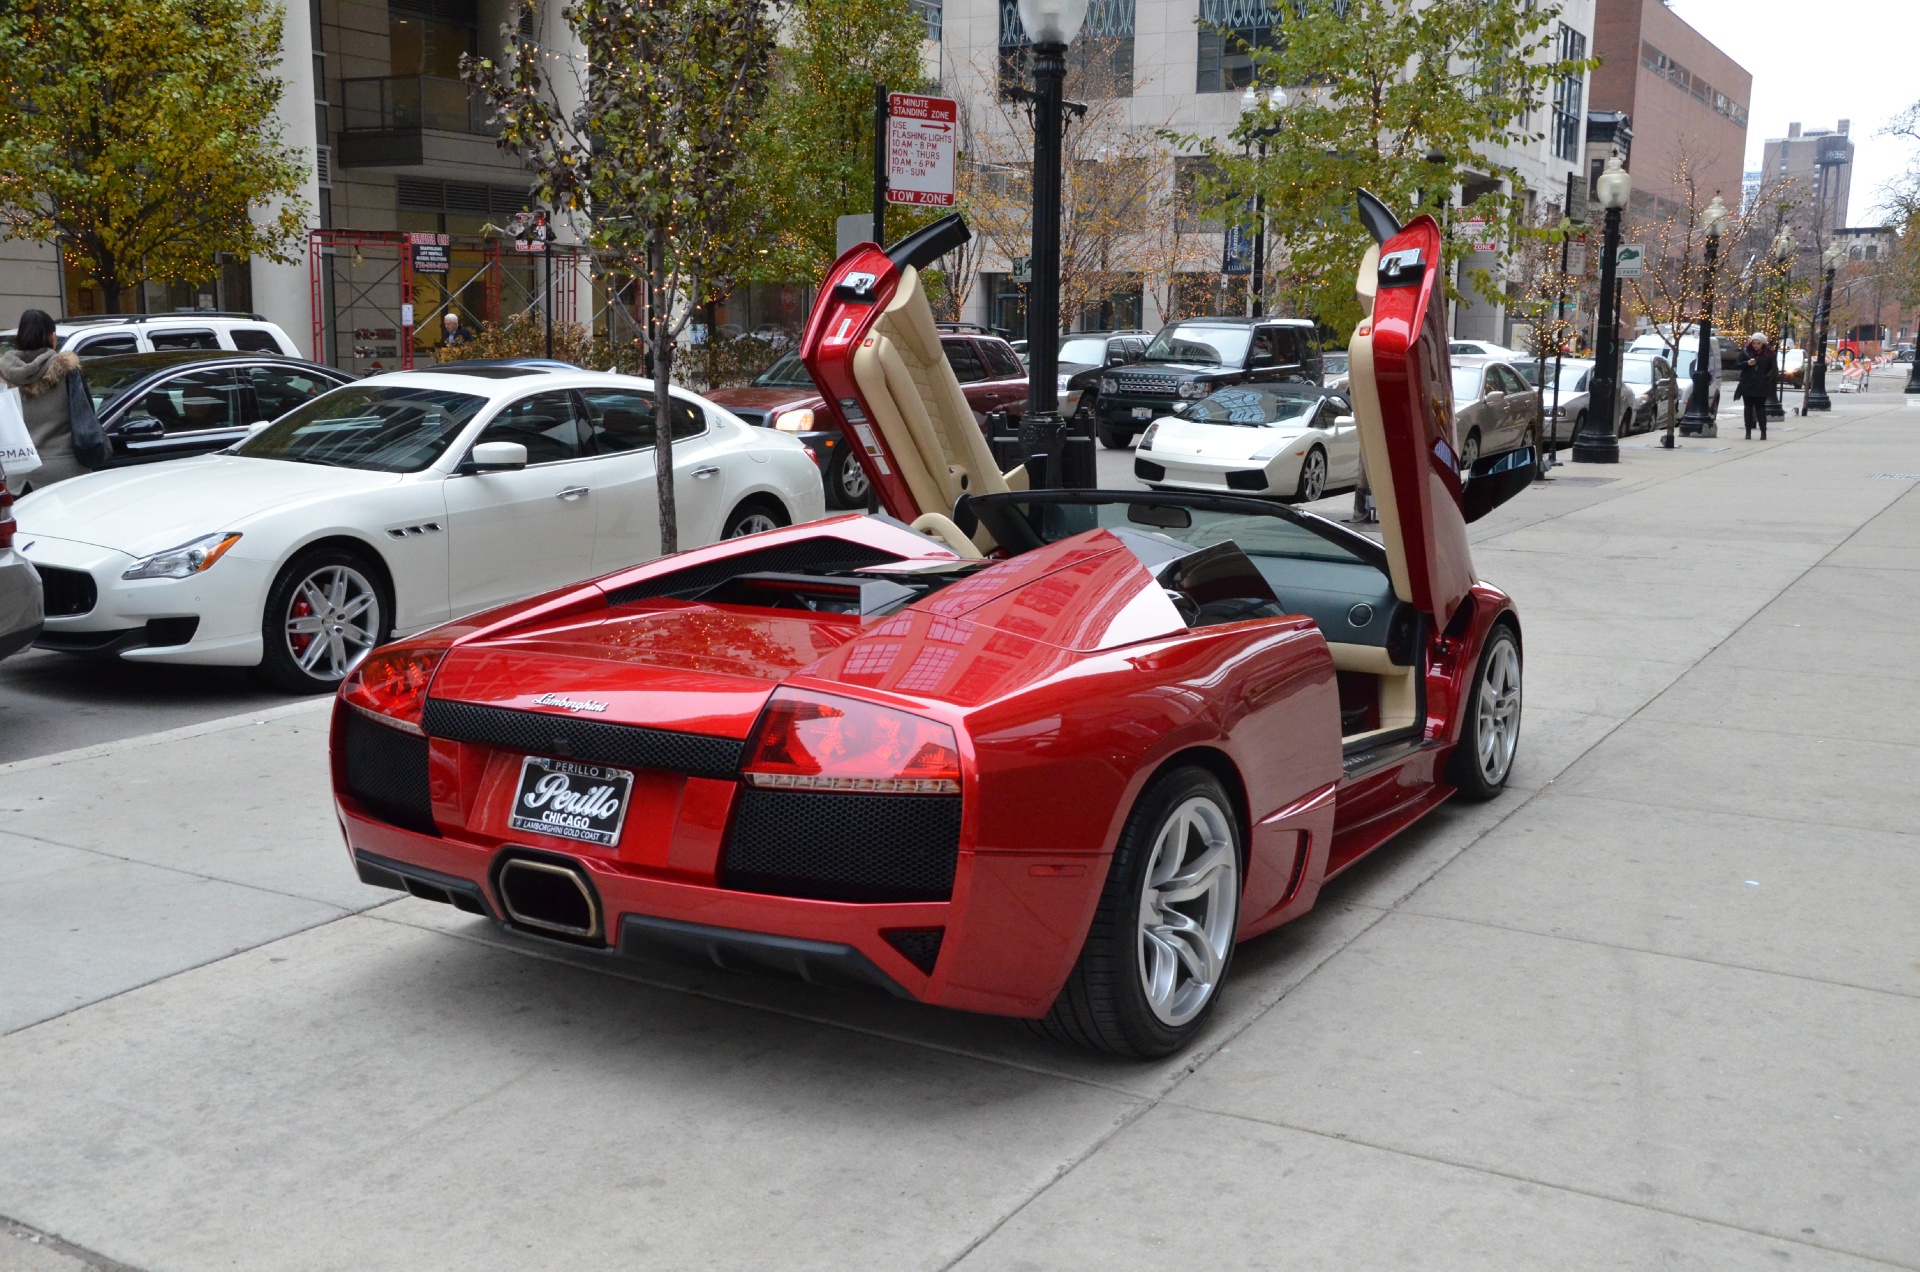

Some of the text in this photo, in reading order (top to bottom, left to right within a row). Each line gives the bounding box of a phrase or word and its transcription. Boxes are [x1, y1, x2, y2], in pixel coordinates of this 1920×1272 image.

[893, 96, 929, 109] 15 MINUTE
[893, 106, 950, 120] STANDING ZONE
[892, 120, 907, 130] USE
[892, 130, 952, 144] FLASHING LIGHTS
[919, 141, 925, 149] 8
[926, 142, 938, 151] PM
[892, 148, 908, 157] MON
[916, 150, 940, 160] THURS
[891, 166, 904, 175] FRI
[910, 168, 926, 177] SUN
[918, 160, 924, 168] 6
[925, 160, 936, 169] PM
[891, 191, 948, 204] TOW ZONE
[410, 232, 450, 246] SERVICE ONE
[532, 692, 608, 712] Lamborghini
[555, 762, 599, 776] PERILLO
[523, 773, 619, 819] Perillo
[542, 810, 590, 829] CHICAGO
[523, 821, 600, 841] LAMBORGHINI GOLD COAST
